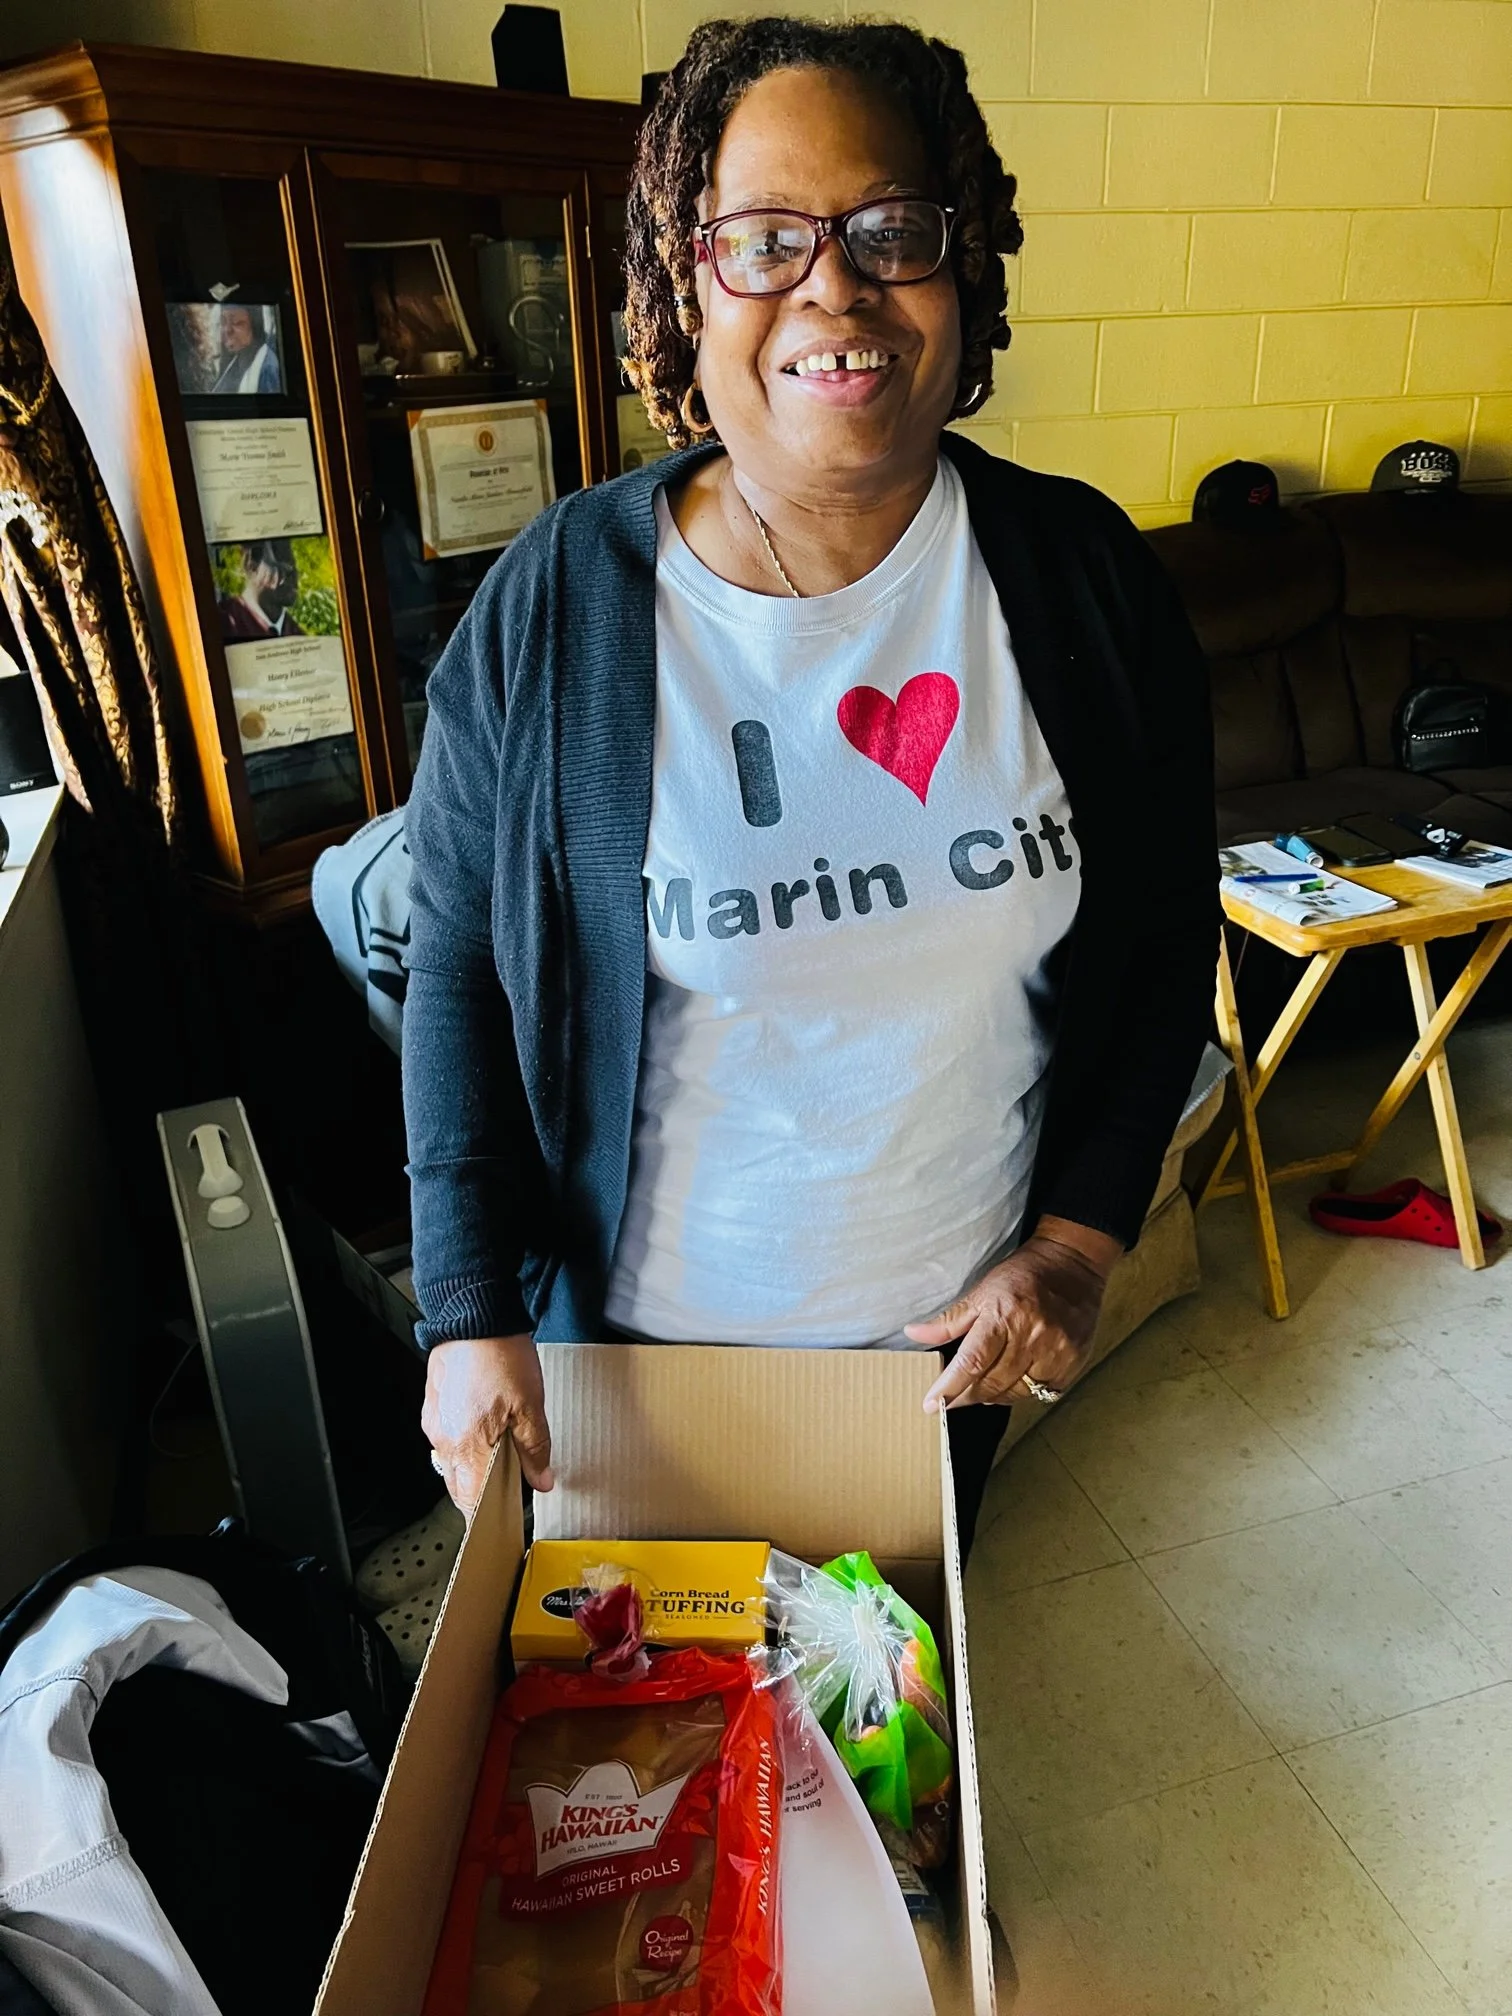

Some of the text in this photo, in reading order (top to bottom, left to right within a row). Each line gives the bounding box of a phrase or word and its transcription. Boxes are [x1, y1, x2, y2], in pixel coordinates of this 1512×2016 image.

[731, 719, 783, 827] I
[647, 814, 1077, 941] Marin Cit
[688, 1590, 729, 1598] Bread
[645, 1600, 745, 1614] TUFFING
[756, 1738, 772, 1839] HAWAIIAN
[561, 1804, 639, 1824] KING'S
[792, 1797, 822, 1812] serving
[541, 1816, 658, 1854] HAWAIIAN
[512, 1858, 681, 1912] HAWAIIAN SWEET ROLLS
[562, 1865, 618, 1887] ORIGINAL
[645, 1930, 689, 1948] Original
[647, 1946, 683, 1962] Recipe
